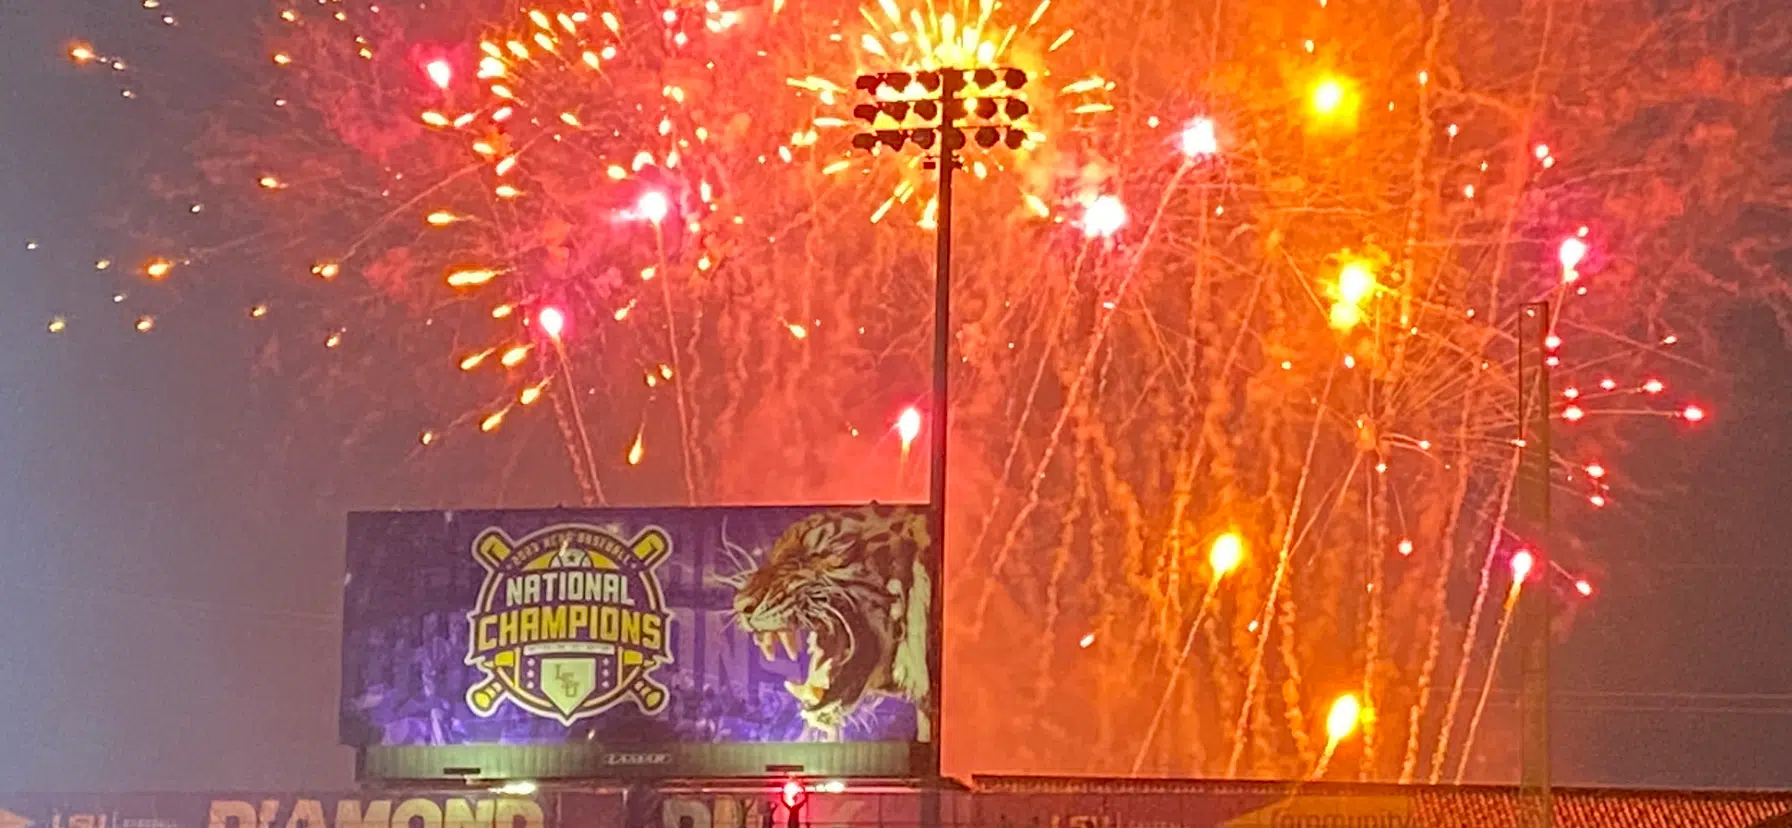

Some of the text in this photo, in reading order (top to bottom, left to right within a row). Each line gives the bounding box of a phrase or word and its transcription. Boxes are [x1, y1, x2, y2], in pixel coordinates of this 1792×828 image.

[506, 571, 635, 607] NATIONAL
[478, 604, 662, 651] CHAMPIONS
[555, 663, 579, 698] LSU
